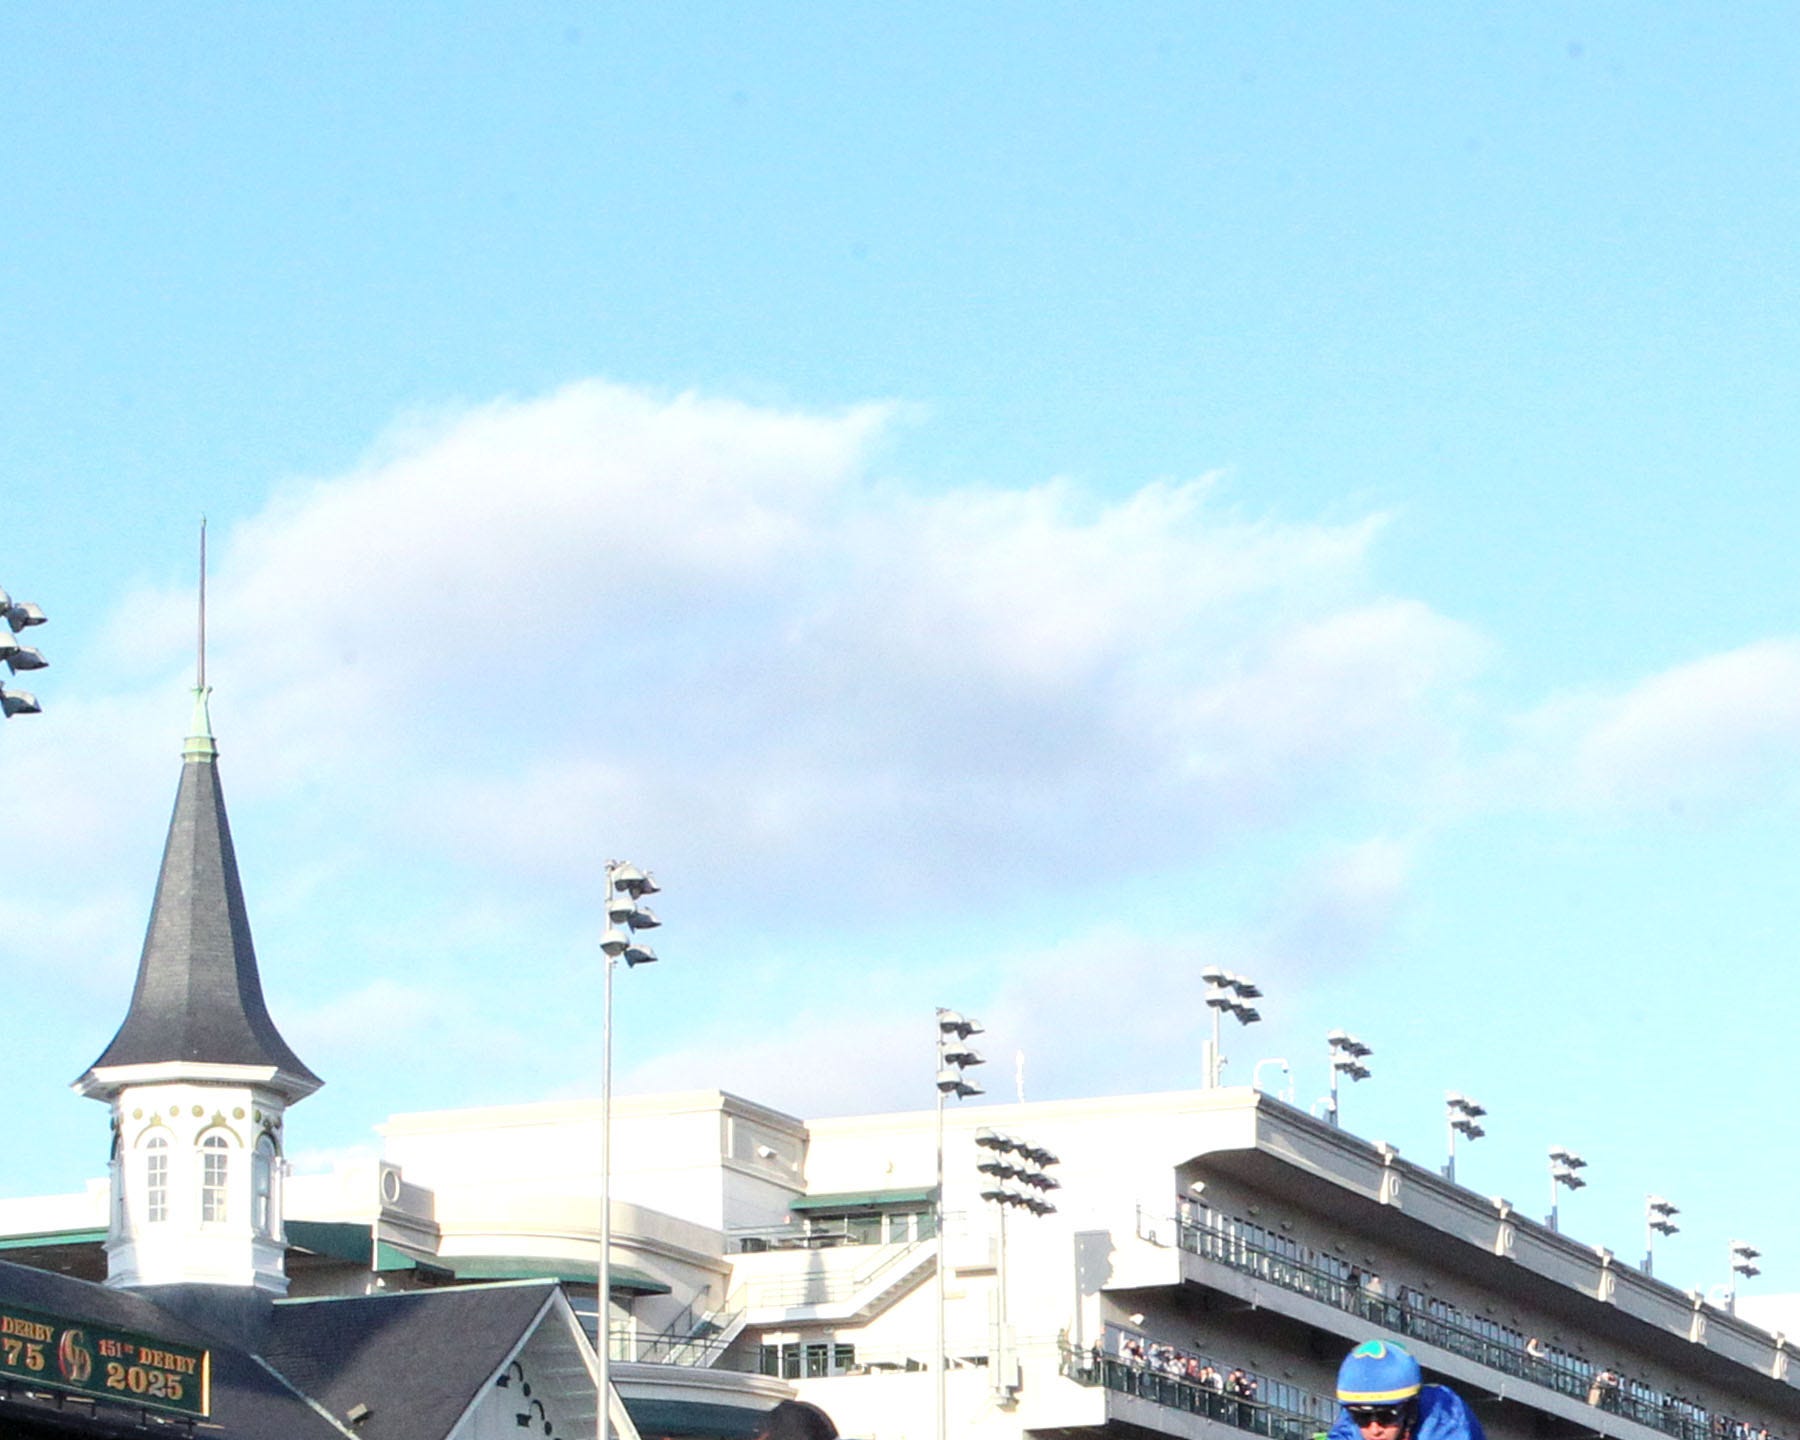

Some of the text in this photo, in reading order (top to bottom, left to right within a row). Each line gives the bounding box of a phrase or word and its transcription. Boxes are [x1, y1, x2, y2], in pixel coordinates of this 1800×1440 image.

[2, 1315, 55, 1343] DERBY
[138, 1347, 197, 1375] DERBY
[106, 1362, 183, 1400] 2025
